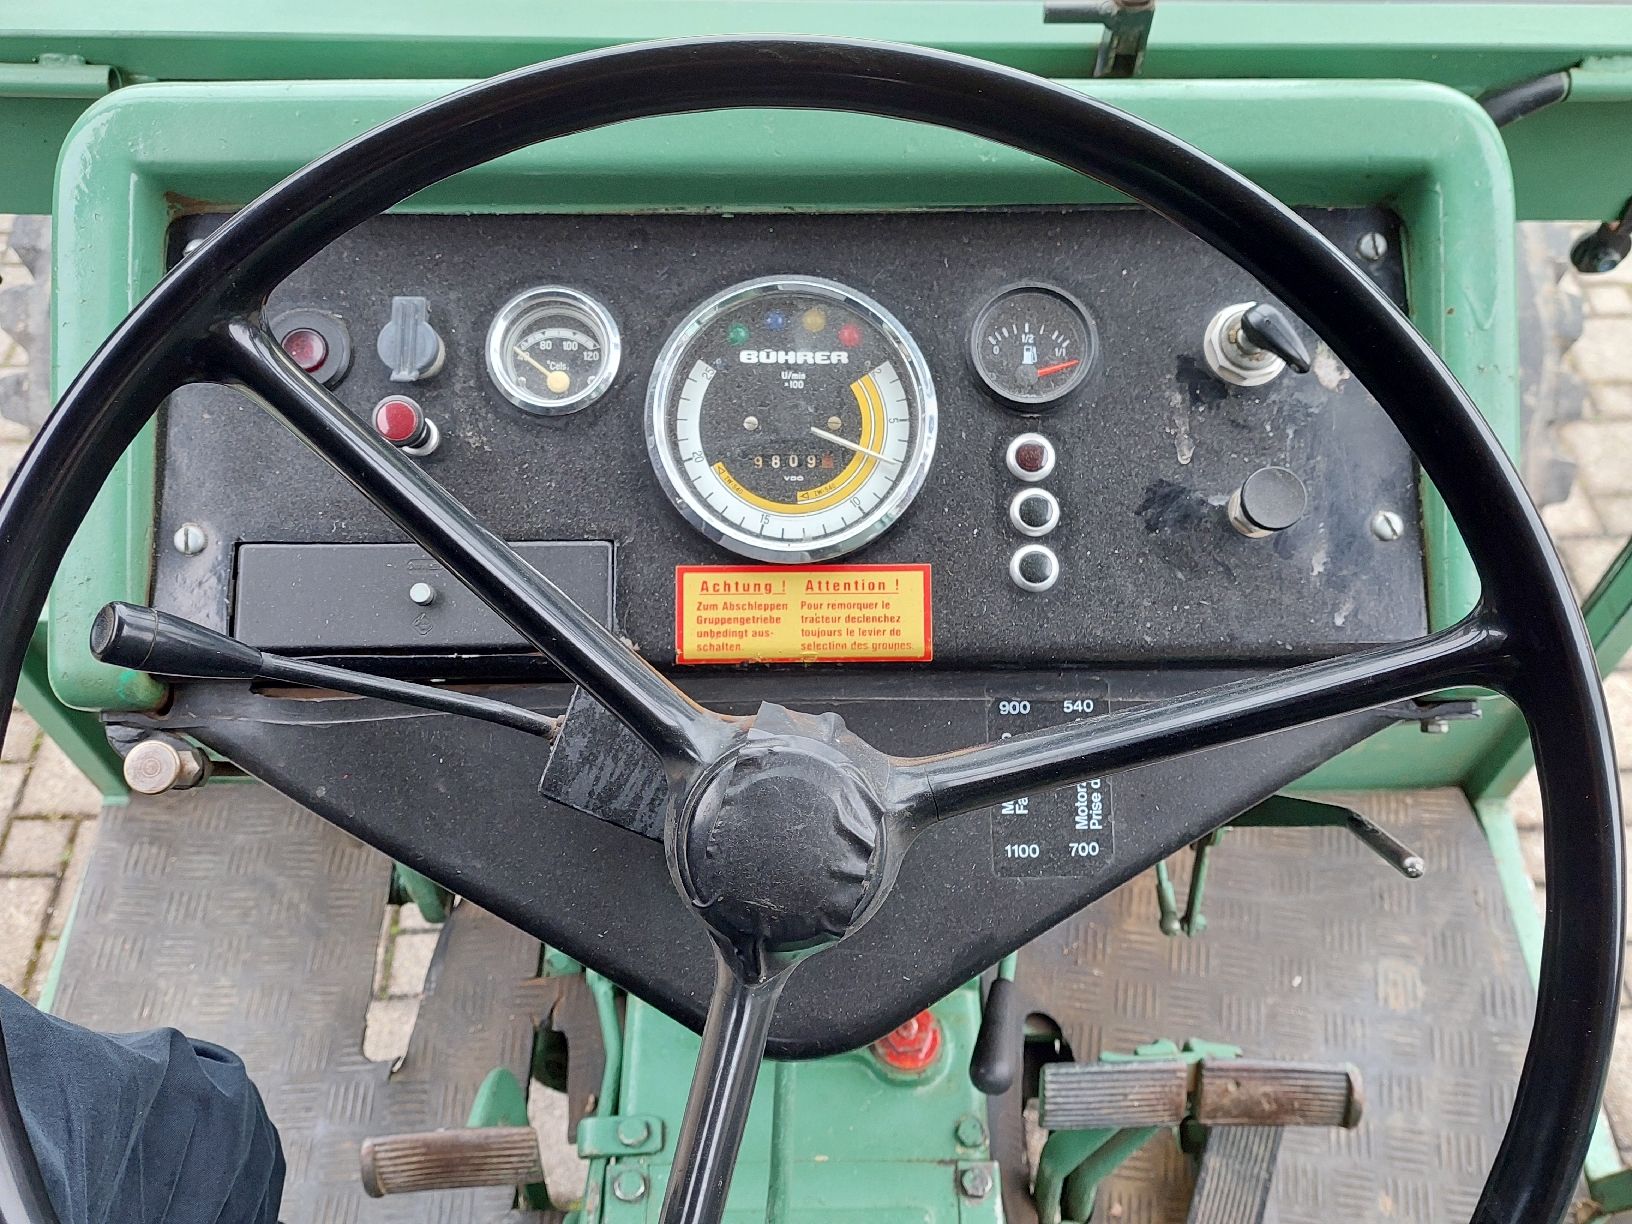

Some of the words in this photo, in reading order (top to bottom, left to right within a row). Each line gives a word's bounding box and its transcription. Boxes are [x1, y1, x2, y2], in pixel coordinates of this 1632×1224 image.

[1022, 334, 1034, 343] 1/2
[540, 341, 552, 350] 80
[563, 341, 578, 351] 100
[993, 346, 1000, 355] 0
[583, 352, 599, 361] 120
[740, 349, 848, 364] BÜHRER
[1055, 347, 1066, 357] 1/1
[702, 367, 714, 380] 25
[781, 371, 805, 380] U/min
[692, 451, 704, 463] 20
[850, 496, 861, 508] 10
[760, 513, 770, 525] 15
[701, 580, 772, 595] Achtung
[805, 579, 886, 592] Attention
[697, 602, 718, 611] Zum
[722, 602, 788, 612] Abschleppen
[801, 601, 823, 610] Pour
[827, 601, 878, 611] remorquer
[882, 600, 890, 610] le
[697, 615, 781, 625] Gruppengetriebe
[801, 615, 841, 624] tracteur
[845, 614, 901, 624] declenchez
[697, 629, 748, 639] unbedingt
[752, 630, 774, 638] aus-
[801, 629, 842, 638] toujours
[846, 628, 855, 637] le
[858, 628, 887, 637] levier
[890, 628, 901, 637] de
[801, 641, 847, 651] selection
[851, 641, 868, 650] des
[999, 701, 1031, 715] 900
[1063, 700, 1094, 713] 540
[1089, 792, 1103, 830] Prise
[1004, 844, 1040, 858] 1100
[1068, 842, 1100, 857] 700
